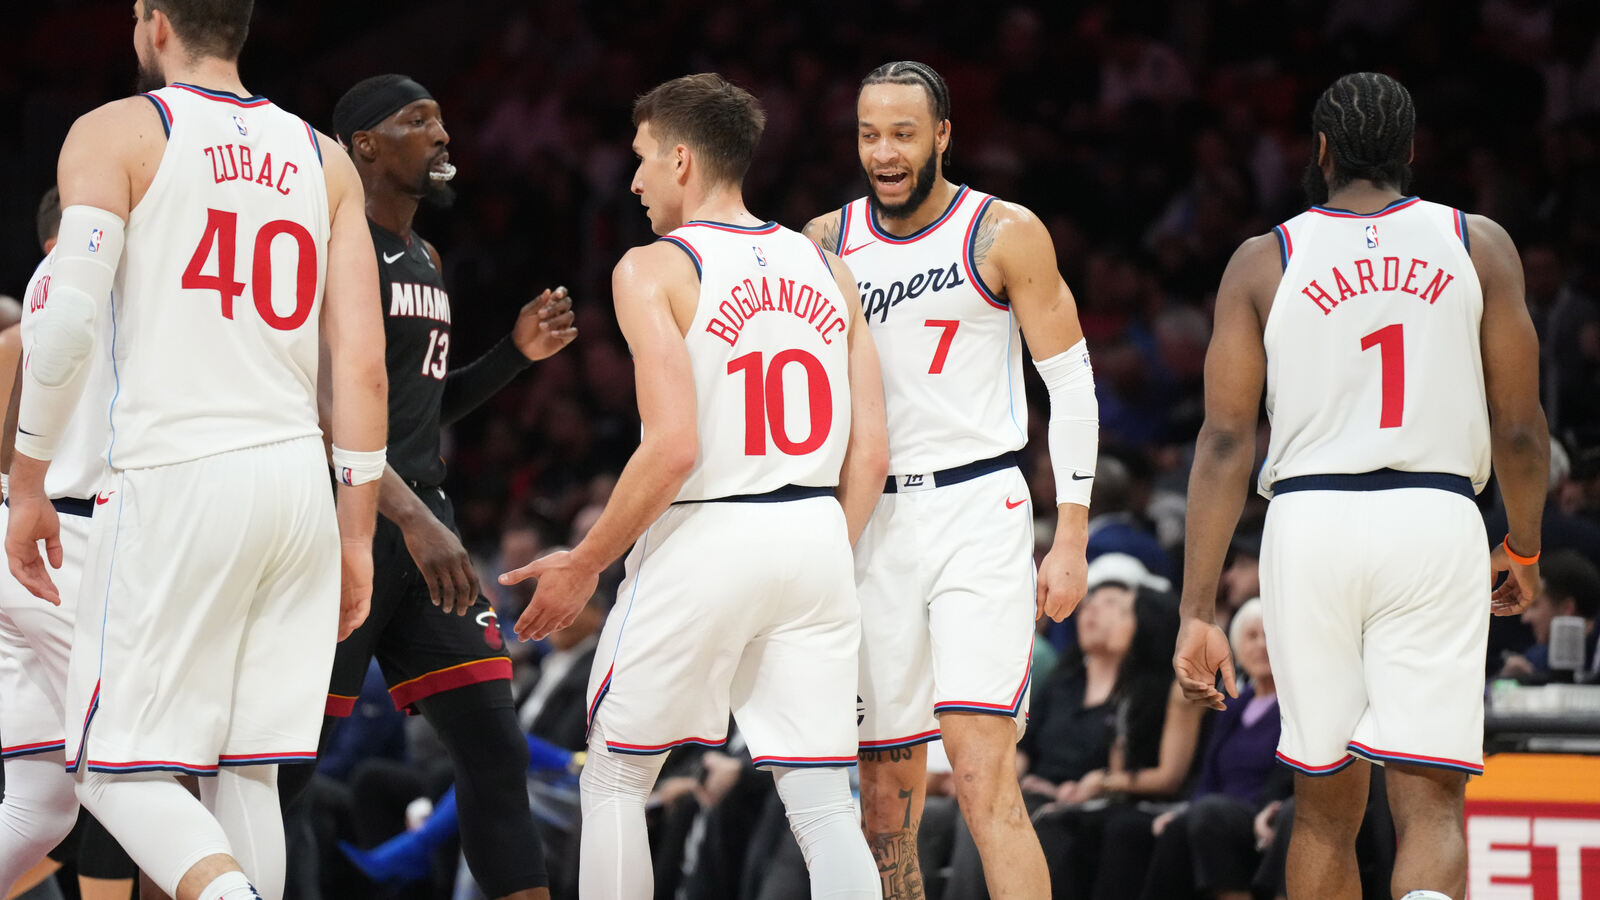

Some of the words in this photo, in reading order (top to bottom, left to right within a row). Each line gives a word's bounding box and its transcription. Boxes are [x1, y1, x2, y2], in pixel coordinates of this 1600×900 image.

[204, 144, 298, 195] ZUBAC
[182, 208, 317, 330] 40
[858, 262, 965, 326] ippers
[1302, 257, 1454, 315] HARDEN
[389, 281, 452, 326] MIAMI
[706, 276, 845, 347] BOGDANOVIC
[421, 328, 450, 381] 13
[924, 320, 960, 374] 7
[1360, 324, 1404, 428] 1
[727, 348, 833, 456] 10
